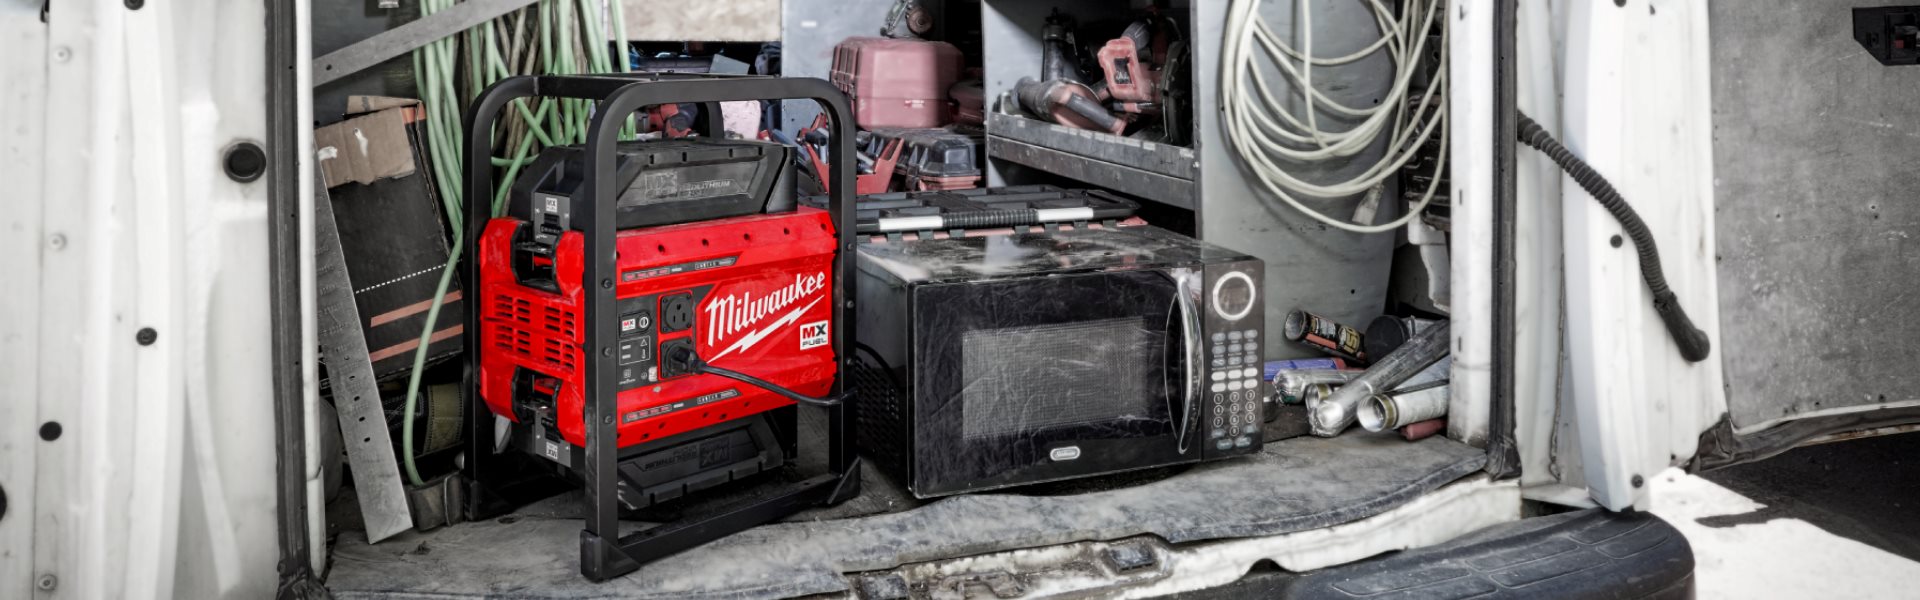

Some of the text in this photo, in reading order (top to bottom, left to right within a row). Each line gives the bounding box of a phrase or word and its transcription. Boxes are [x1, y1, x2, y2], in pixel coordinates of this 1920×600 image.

[704, 271, 826, 348] Milwaukee
[802, 323, 827, 340] MX
[802, 337, 827, 348] FUEL
